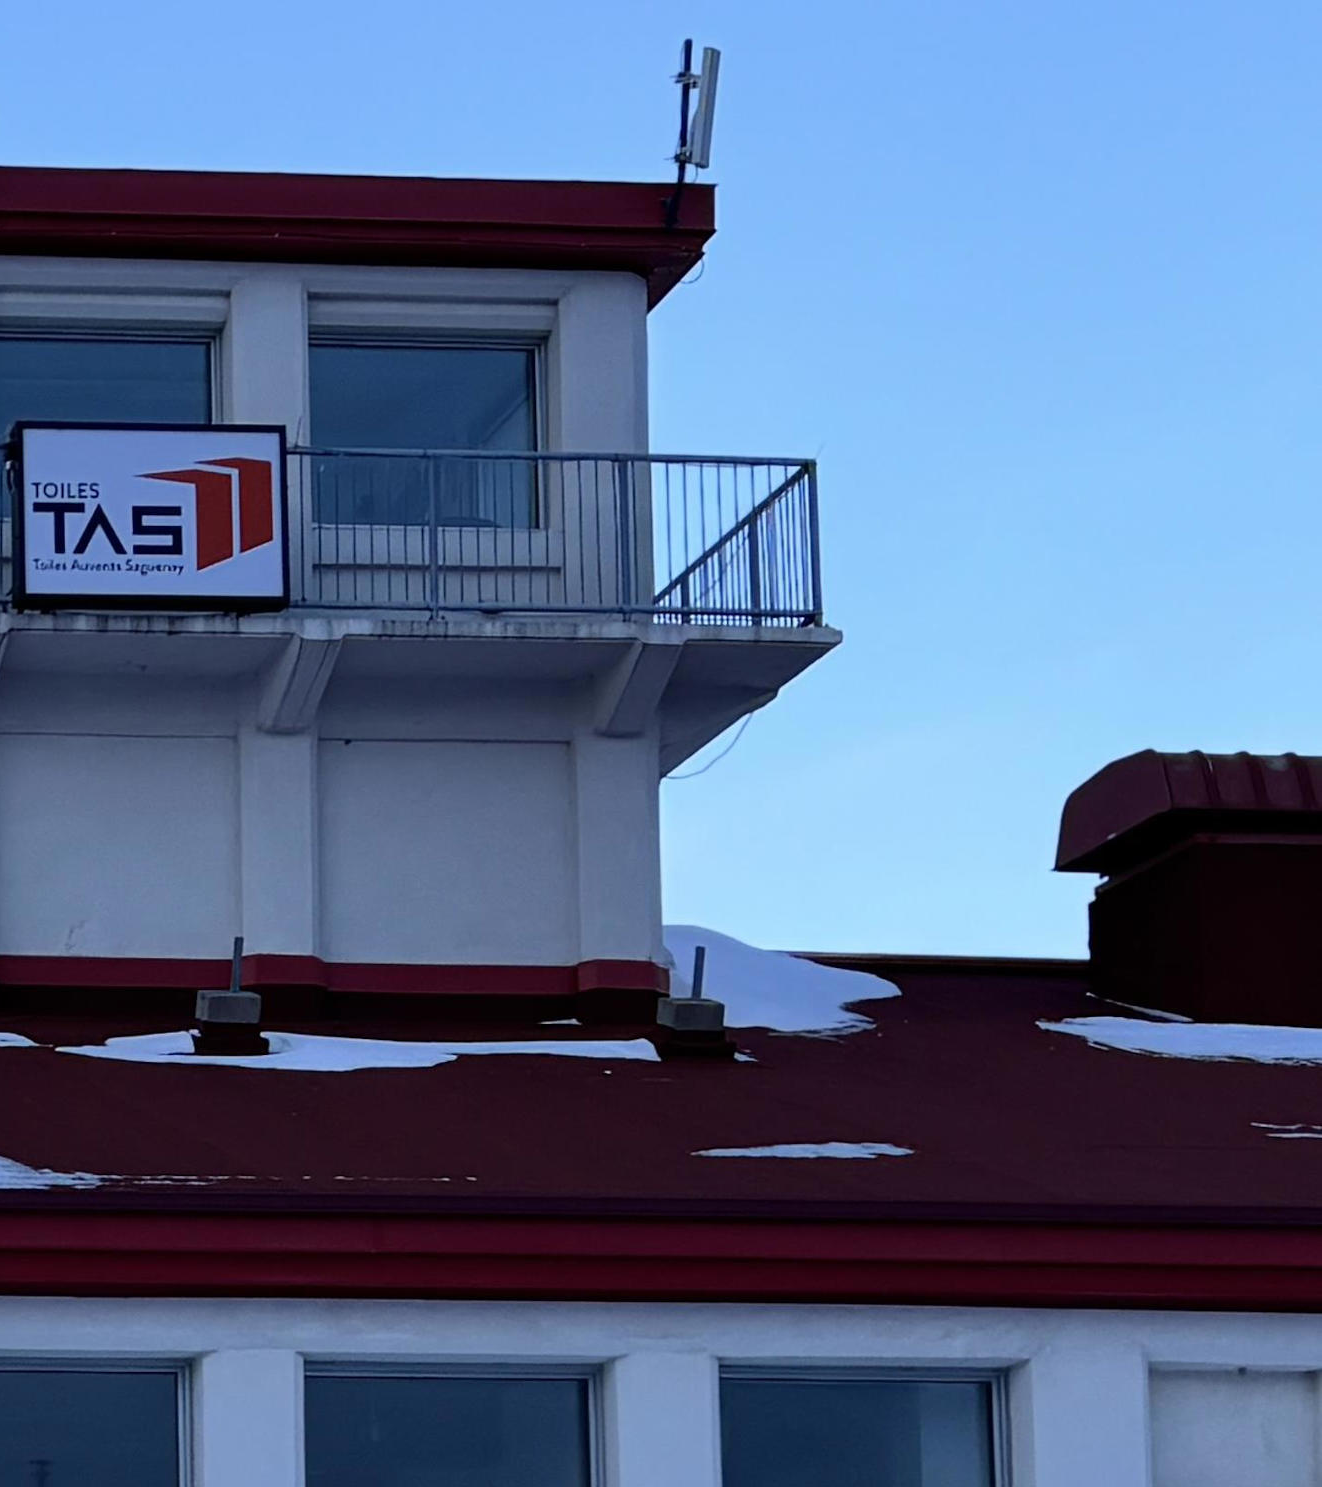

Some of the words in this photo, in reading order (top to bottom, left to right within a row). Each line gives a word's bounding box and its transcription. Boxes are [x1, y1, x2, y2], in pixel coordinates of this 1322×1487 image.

[31, 482, 99, 499] TOILES
[32, 502, 183, 555] TAS
[32, 558, 67, 571] Toiles
[70, 559, 121, 572] Auvents
[125, 559, 184, 576] Saguenay
